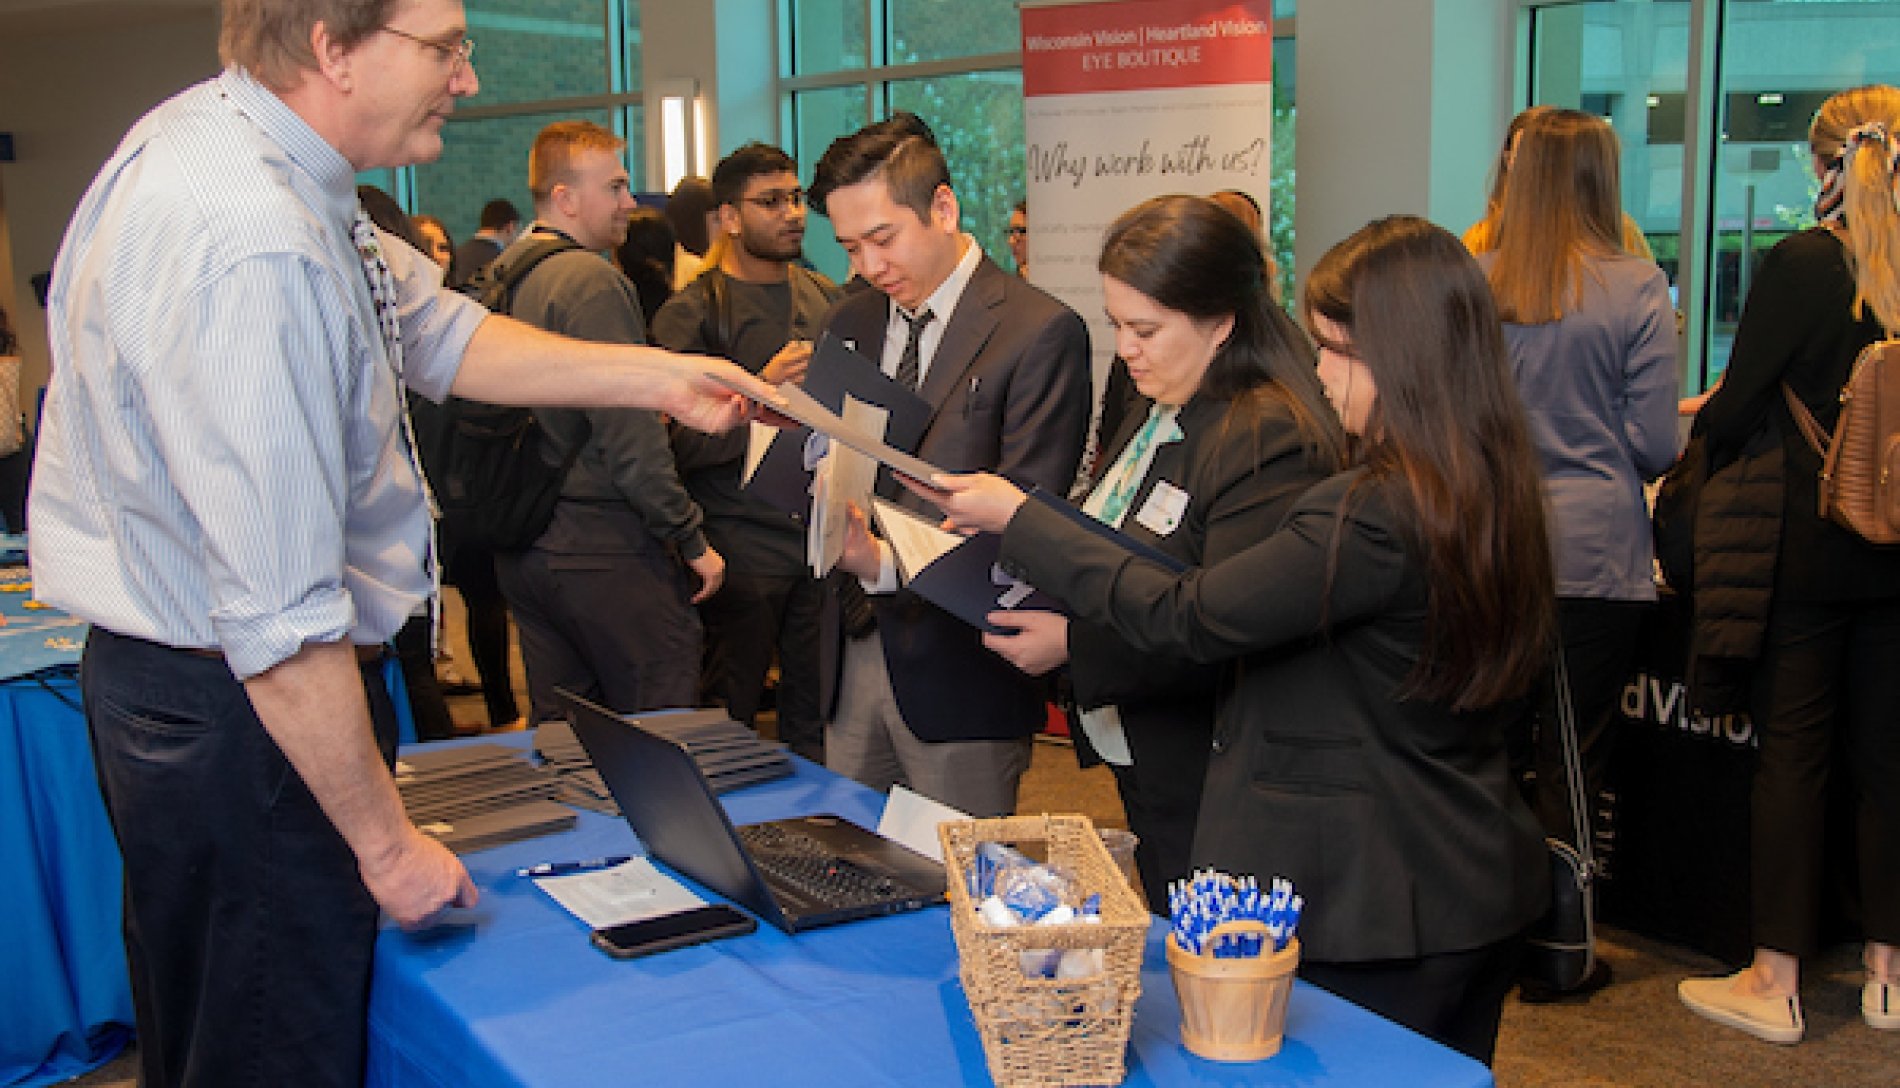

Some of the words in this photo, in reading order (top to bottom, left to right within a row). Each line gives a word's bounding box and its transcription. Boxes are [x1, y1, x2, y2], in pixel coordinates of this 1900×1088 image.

[1026, 33, 1091, 51] Wisconsin
[1093, 29, 1137, 46] Vision
[1146, 20, 1217, 41] Heartland
[1219, 19, 1267, 37] Vision
[1082, 52, 1112, 72] EYE
[1117, 46, 1200, 69] BOUTIQUE
[1028, 141, 1087, 188] Why
[1095, 138, 1155, 176] work
[1161, 135, 1215, 176] with
[1221, 138, 1266, 176] us?
